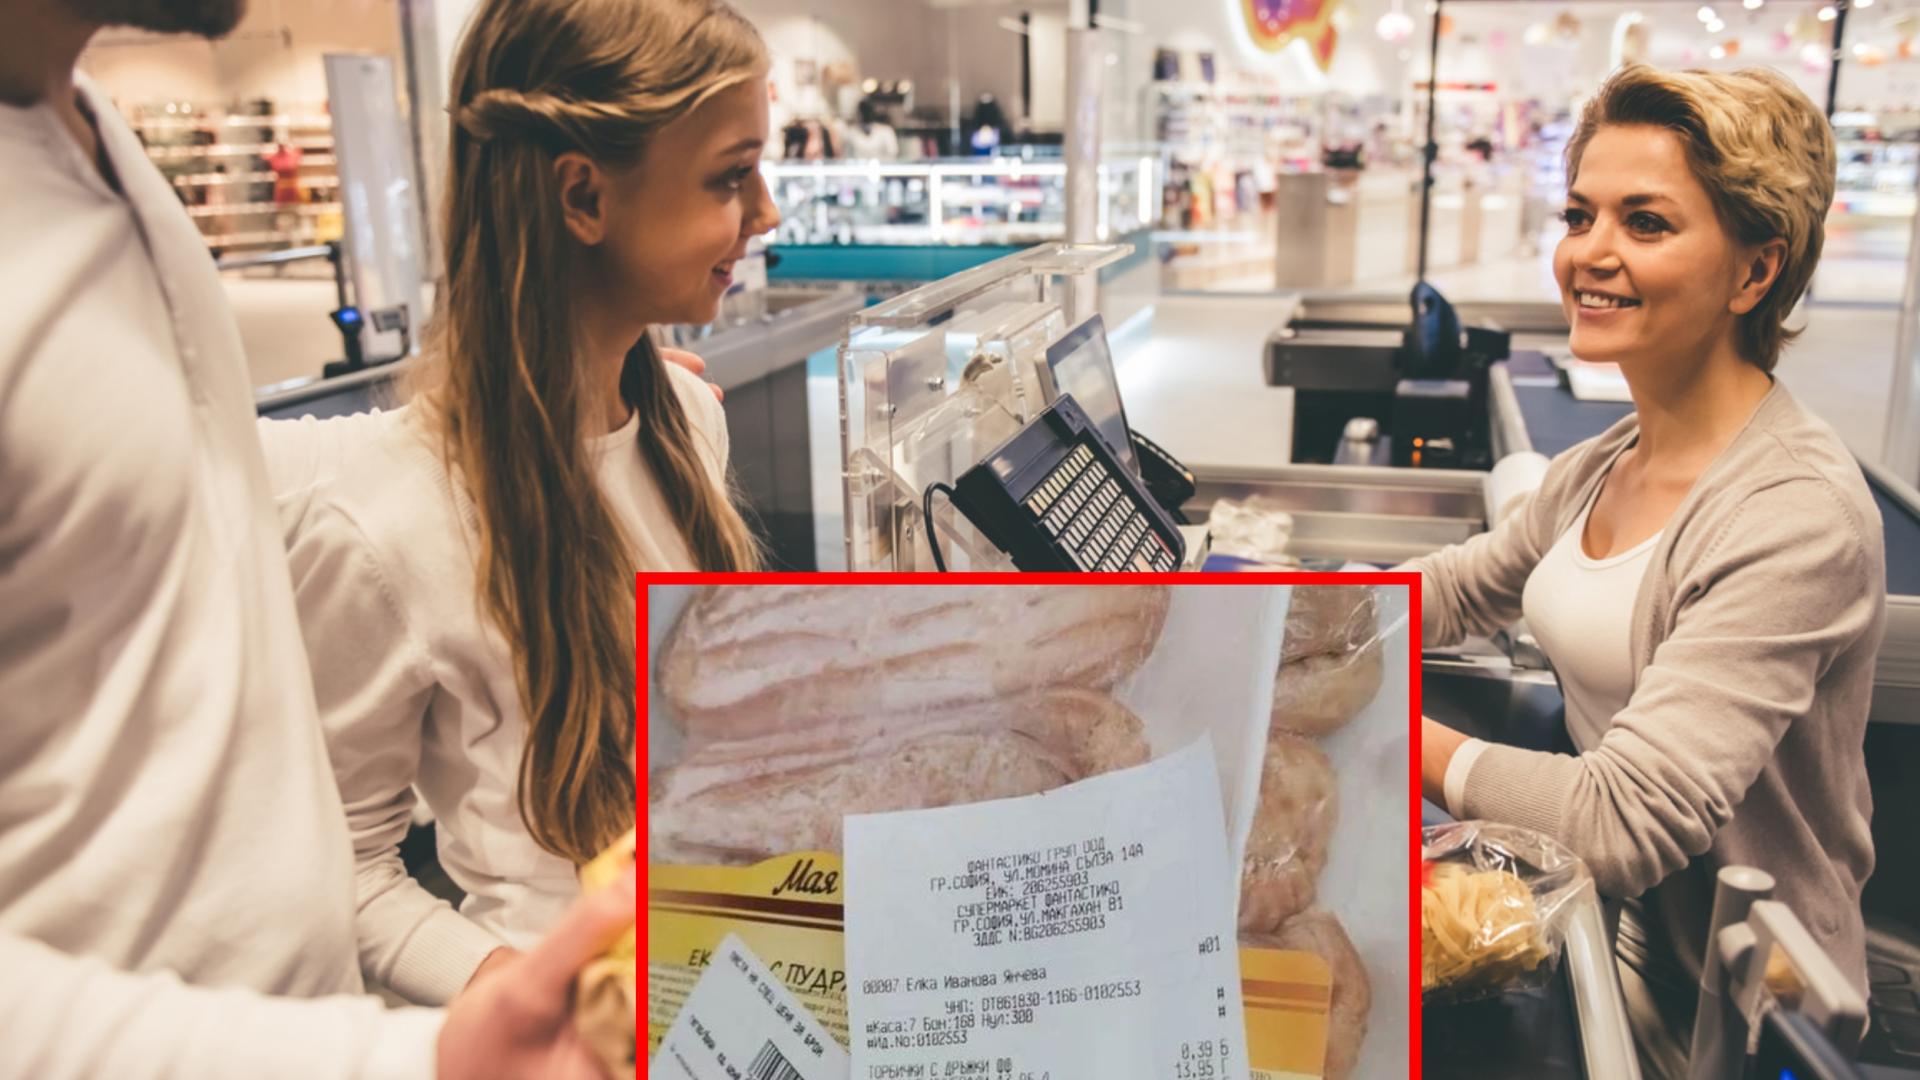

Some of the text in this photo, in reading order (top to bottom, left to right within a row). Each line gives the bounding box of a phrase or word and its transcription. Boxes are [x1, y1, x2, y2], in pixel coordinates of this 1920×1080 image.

[1047, 844, 1077, 860] ГРУП
[1076, 850, 1114, 871] СЪЛЗА
[772, 858, 839, 896] Мая
[1022, 871, 1090, 896] 206255903
[957, 880, 1120, 918] СУПЕРМАРКЕТ ФАНТАСТИКО
[785, 963, 847, 995] ПУДР
[906, 977, 938, 992] Елка
[943, 973, 997, 989] Иванова
